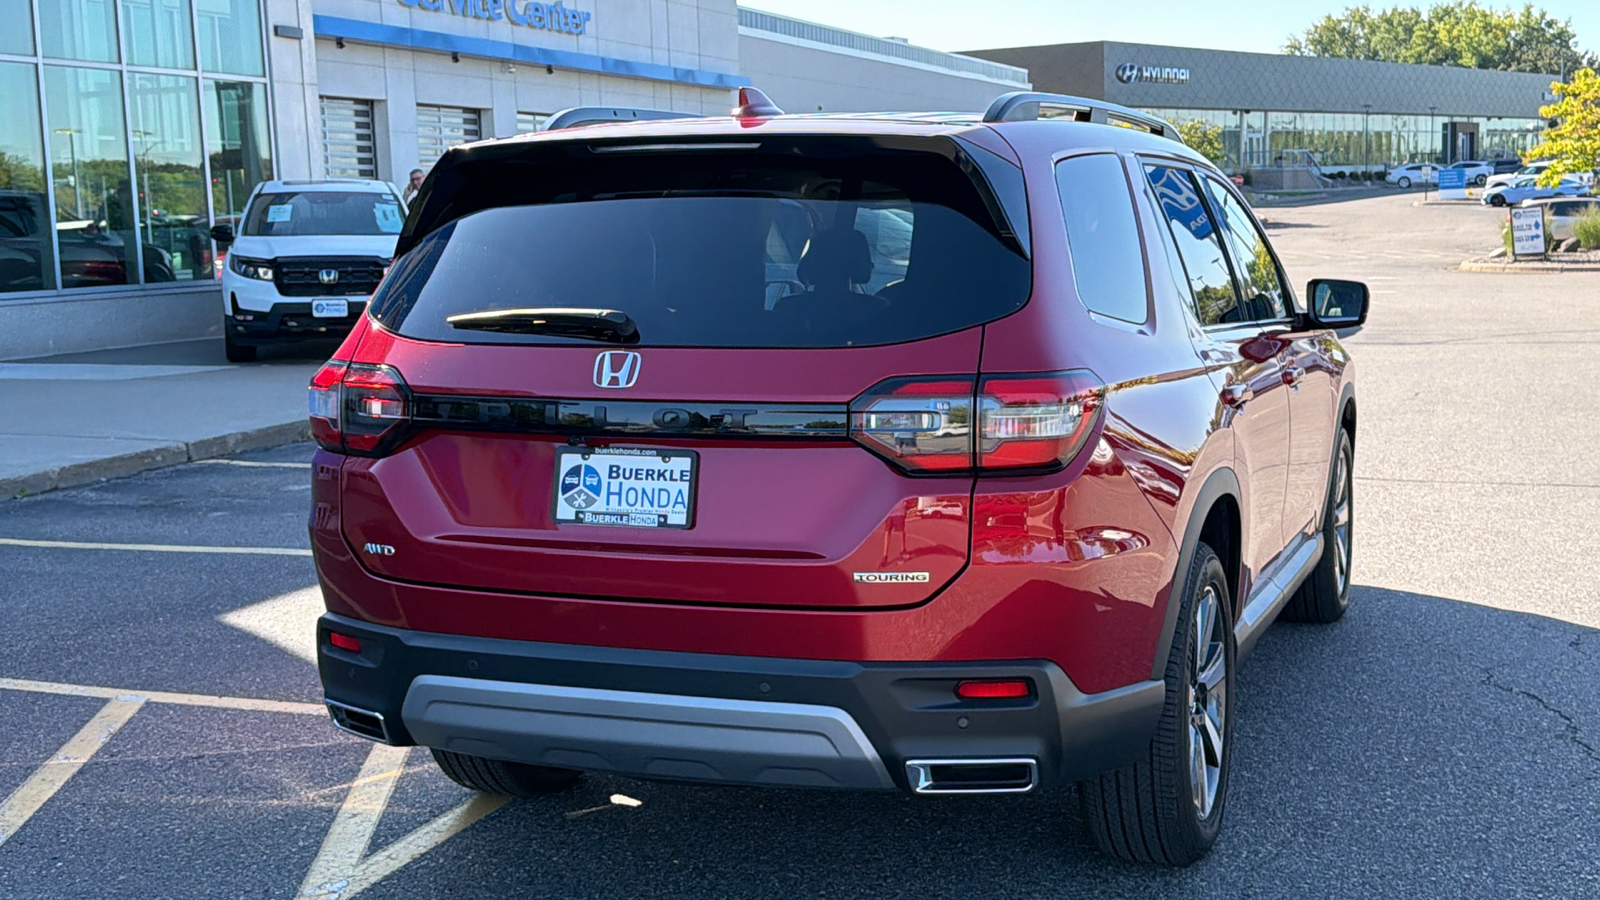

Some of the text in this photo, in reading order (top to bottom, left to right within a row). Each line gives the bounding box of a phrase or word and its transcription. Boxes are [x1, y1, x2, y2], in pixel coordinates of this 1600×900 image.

[397, 0, 591, 34] vice Center
[1142, 66, 1190, 82] HYUNDAI
[478, 402, 758, 429] PILOT
[595, 448, 657, 456] buerklehonda.com
[608, 464, 690, 482] BUERKLE
[605, 481, 687, 509] HONDA
[584, 512, 657, 525] BUERKLE HONDA
[363, 542, 396, 556] AWD
[856, 573, 928, 582] TOURING
